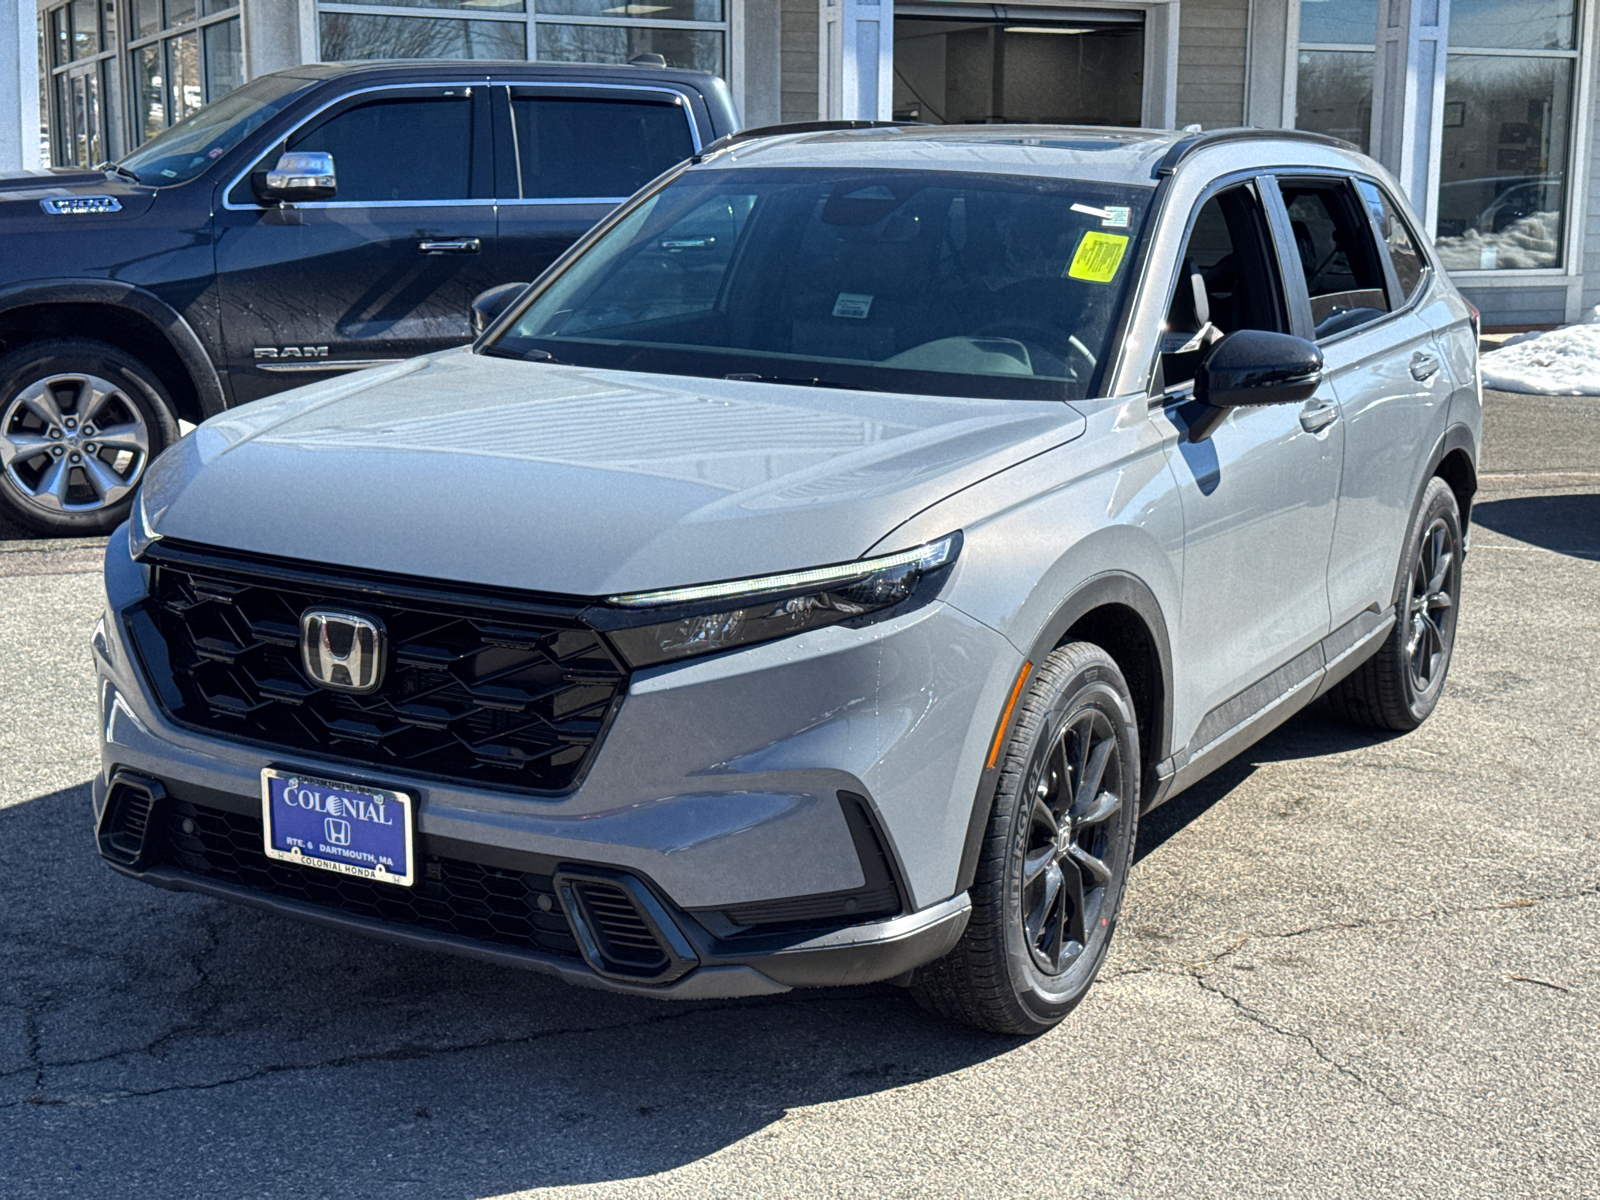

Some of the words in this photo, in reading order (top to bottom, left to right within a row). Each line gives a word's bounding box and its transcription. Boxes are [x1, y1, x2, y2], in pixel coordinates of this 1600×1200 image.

[253, 346, 329, 358] RAM
[283, 787, 393, 825] COLONIAL
[286, 836, 305, 848] RTE.
[319, 844, 377, 863] DARTMOUTH,
[379, 856, 393, 866] MA
[300, 856, 342, 871] COLONIAL
[345, 866, 376, 878] HONDA
